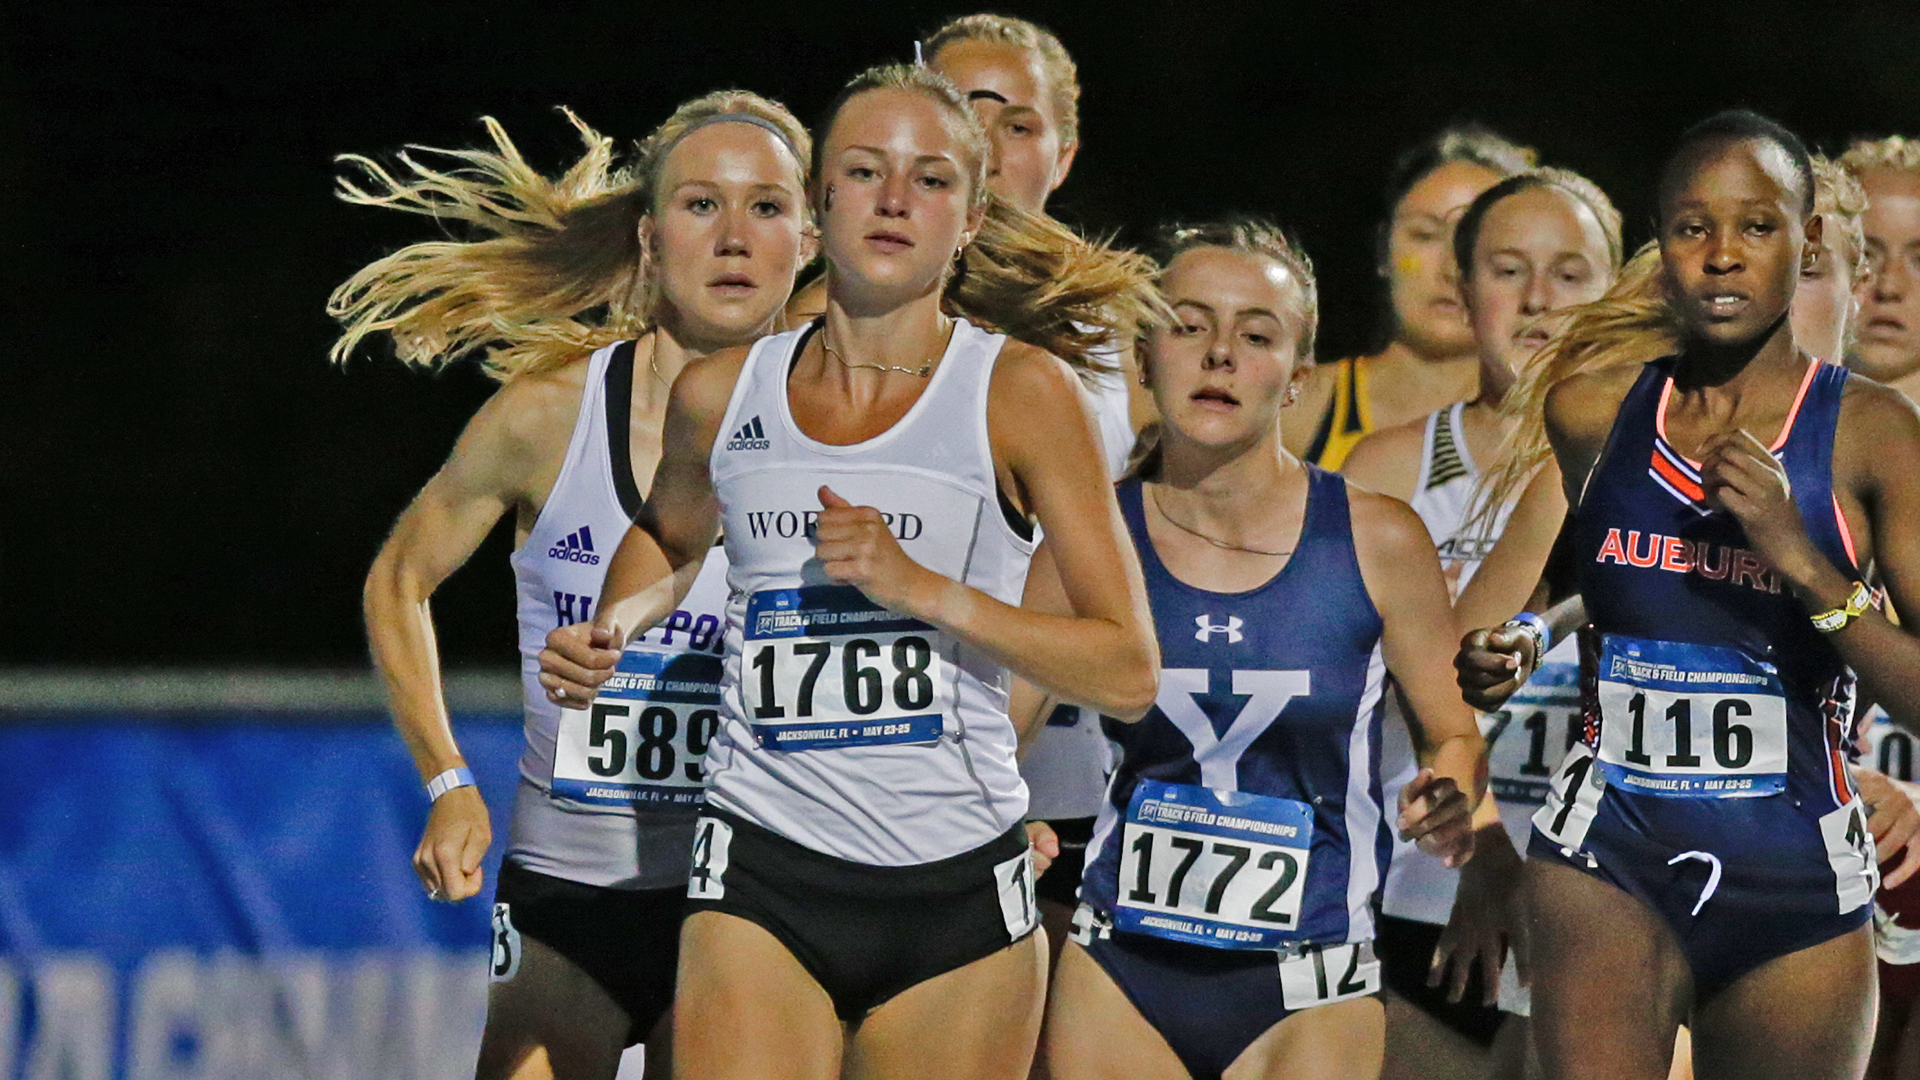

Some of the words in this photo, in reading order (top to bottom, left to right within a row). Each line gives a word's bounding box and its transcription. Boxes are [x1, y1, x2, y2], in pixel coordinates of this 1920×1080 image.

[727, 438, 770, 451] adidas
[747, 510, 923, 541] WOFD
[548, 547, 600, 565] adidas
[773, 615, 801, 628] TRACK
[811, 613, 838, 625] FIELD
[601, 677, 628, 689] RACK
[636, 678, 665, 691] FIELD
[752, 636, 933, 719] 1768
[1627, 665, 1653, 679] TRACK
[1660, 670, 1686, 683] FIELD
[1686, 671, 1769, 686] CHAMPIONSHIPS
[776, 728, 838, 741] JACKSONVILLE,
[838, 728, 848, 738] FL
[863, 725, 883, 737] MAY
[883, 723, 911, 735] 23-25
[1154, 668, 1310, 791] Y
[1625, 693, 1753, 769] 116
[587, 703, 720, 783] 589
[1680, 780, 1691, 790] FL
[1704, 780, 1724, 790] MAY
[1724, 778, 1752, 790] 23-25
[650, 793, 660, 801] FL
[1157, 806, 1183, 820] TRACK
[1191, 812, 1216, 825] FIELD
[1215, 816, 1298, 838] CHAMPIONSHIPS
[692, 823, 714, 892] 4
[1128, 831, 1298, 924] 1772
[1193, 924, 1204, 935] FL
[1215, 928, 1236, 940] MAY
